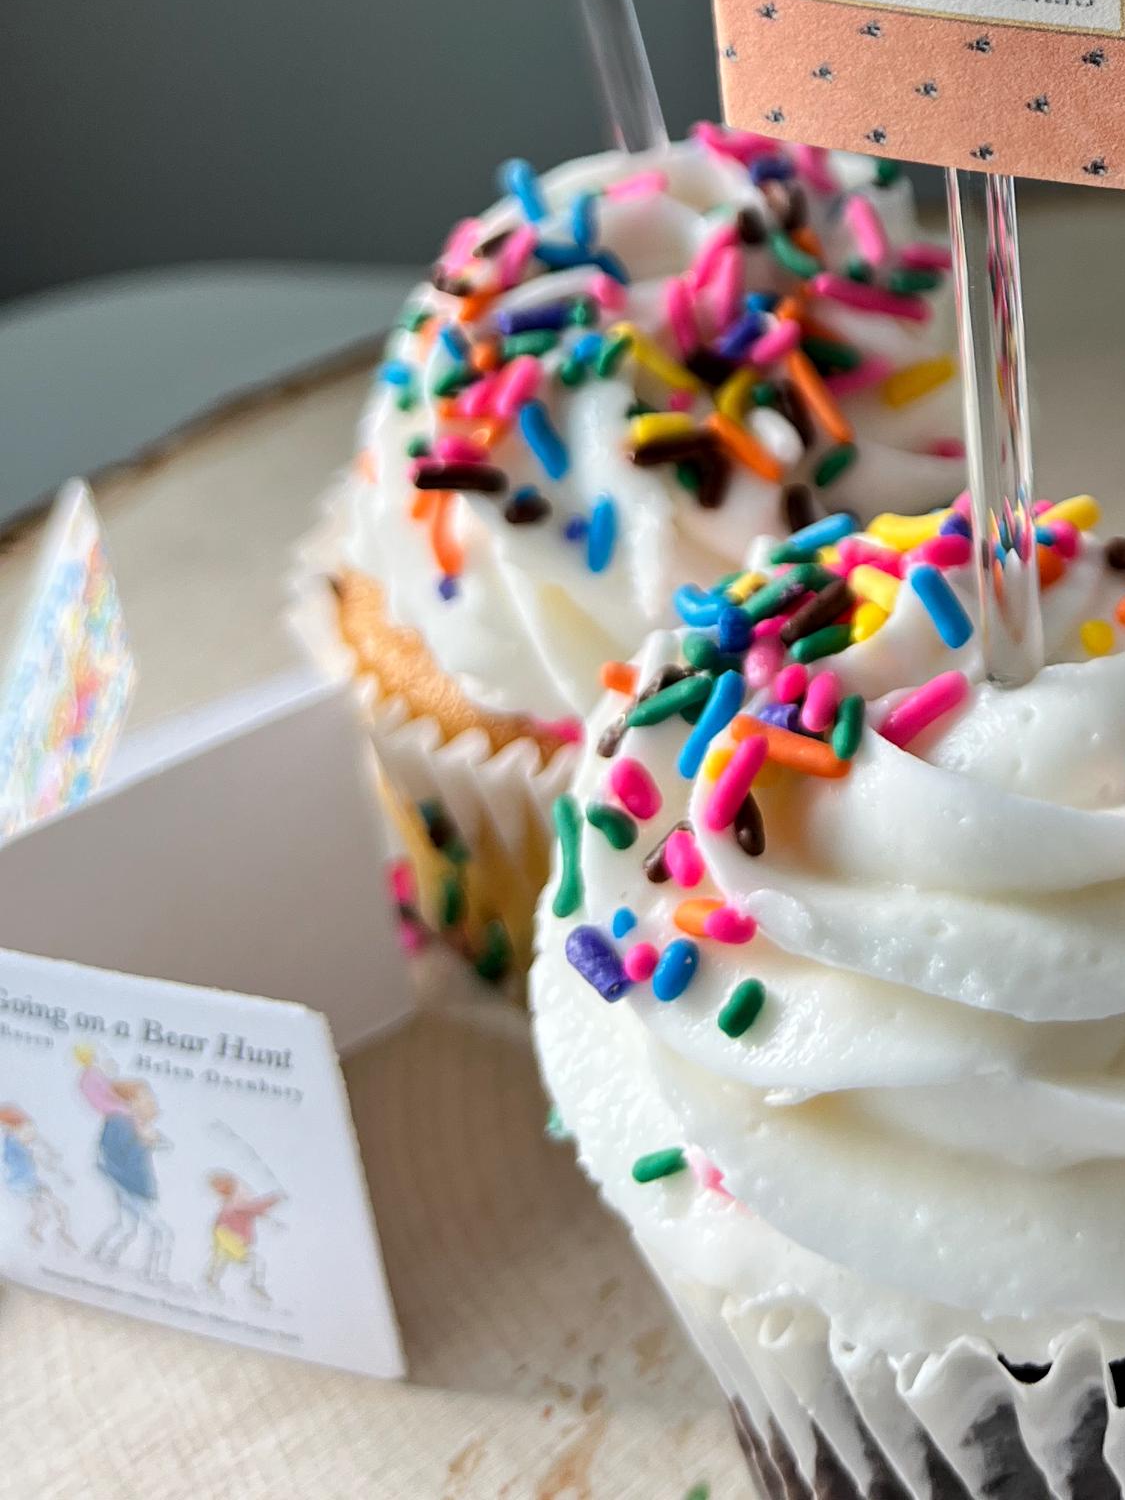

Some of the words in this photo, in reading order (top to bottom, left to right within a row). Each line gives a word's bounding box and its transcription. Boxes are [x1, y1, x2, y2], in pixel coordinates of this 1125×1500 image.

[73, 1010, 106, 1034] on
[113, 1018, 131, 1038] a
[142, 1017, 209, 1053] Bear
[215, 1032, 293, 1069] Hunt
